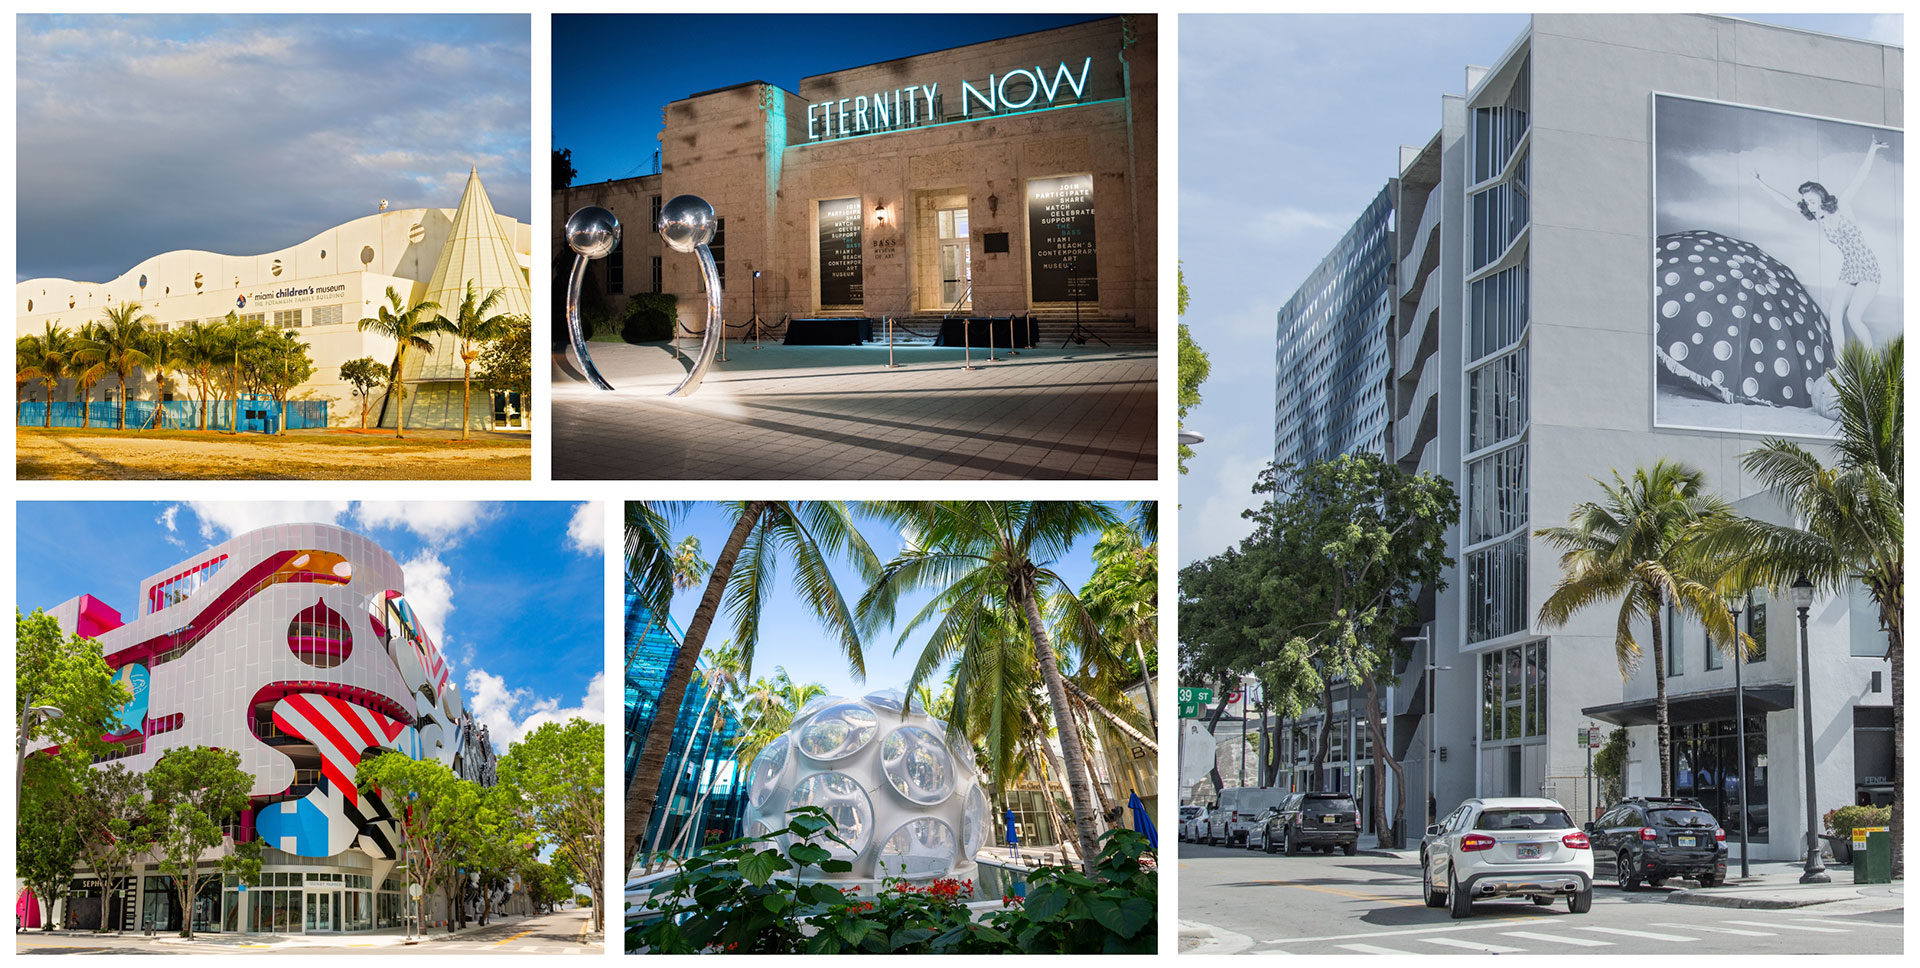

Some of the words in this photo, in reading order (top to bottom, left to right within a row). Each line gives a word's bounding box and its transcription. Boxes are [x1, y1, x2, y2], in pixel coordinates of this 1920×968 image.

[807, 82, 938, 140] ETERNITY
[962, 57, 1092, 117] NOW
[1035, 189, 1089, 199] PARTICIPATE
[1060, 196, 1084, 204] SHARE
[1050, 209, 1095, 217] CELEBRATE
[1041, 217, 1076, 225] SUPPORT
[873, 239, 897, 248] BASS
[254, 291, 275, 301] miami
[275, 286, 315, 299] children's
[316, 284, 345, 294] museum
[1179, 689, 1192, 702] 39
[1198, 692, 1209, 701] ST
[1185, 705, 1195, 714] AV
